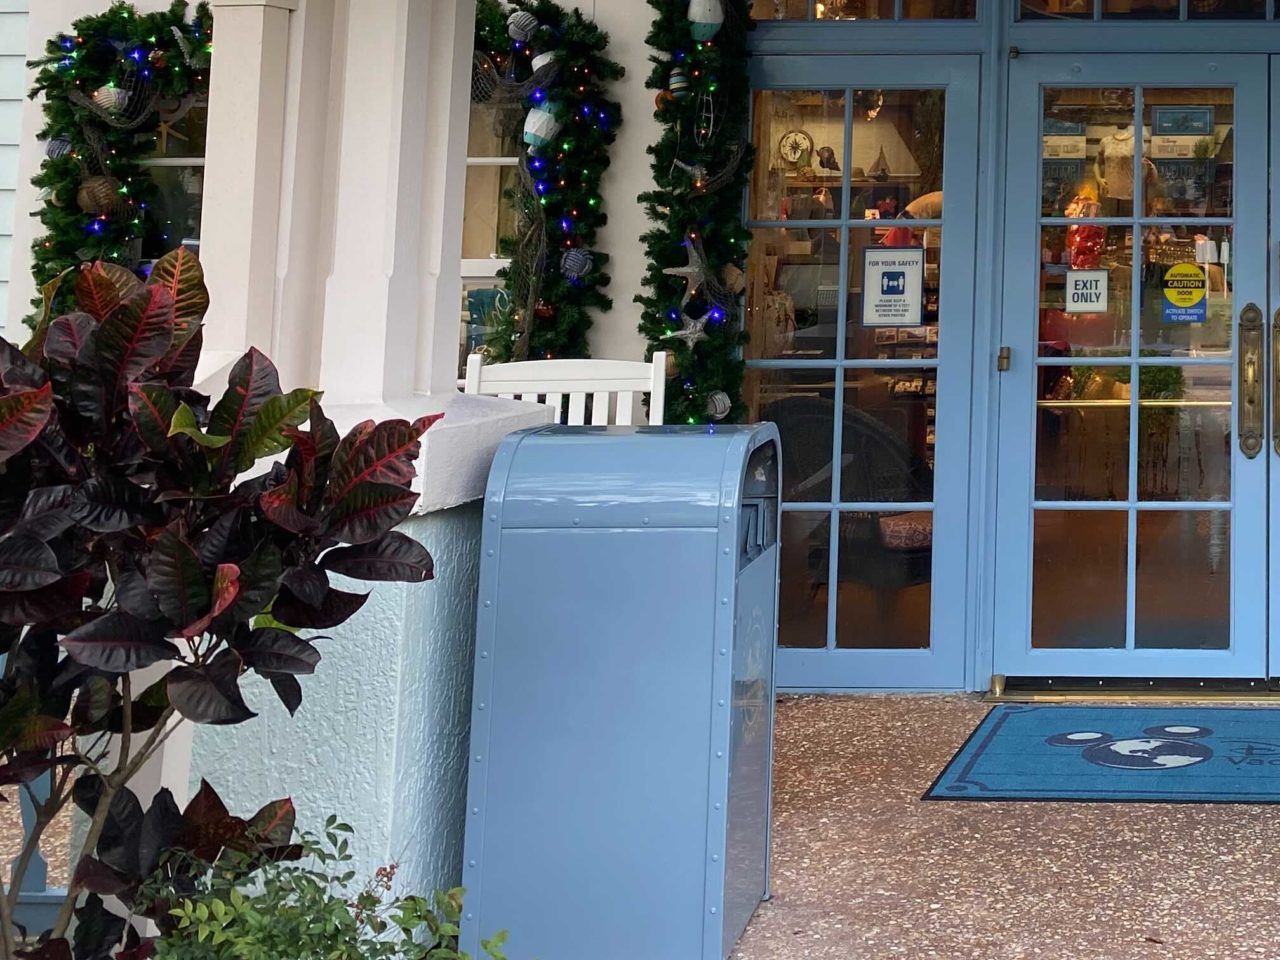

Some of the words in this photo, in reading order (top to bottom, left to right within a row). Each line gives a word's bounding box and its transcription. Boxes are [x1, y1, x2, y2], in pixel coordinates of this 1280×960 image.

[1074, 279, 1101, 291] EXIT
[1167, 280, 1202, 288] CAUTION
[1072, 292, 1102, 303] ONLY
